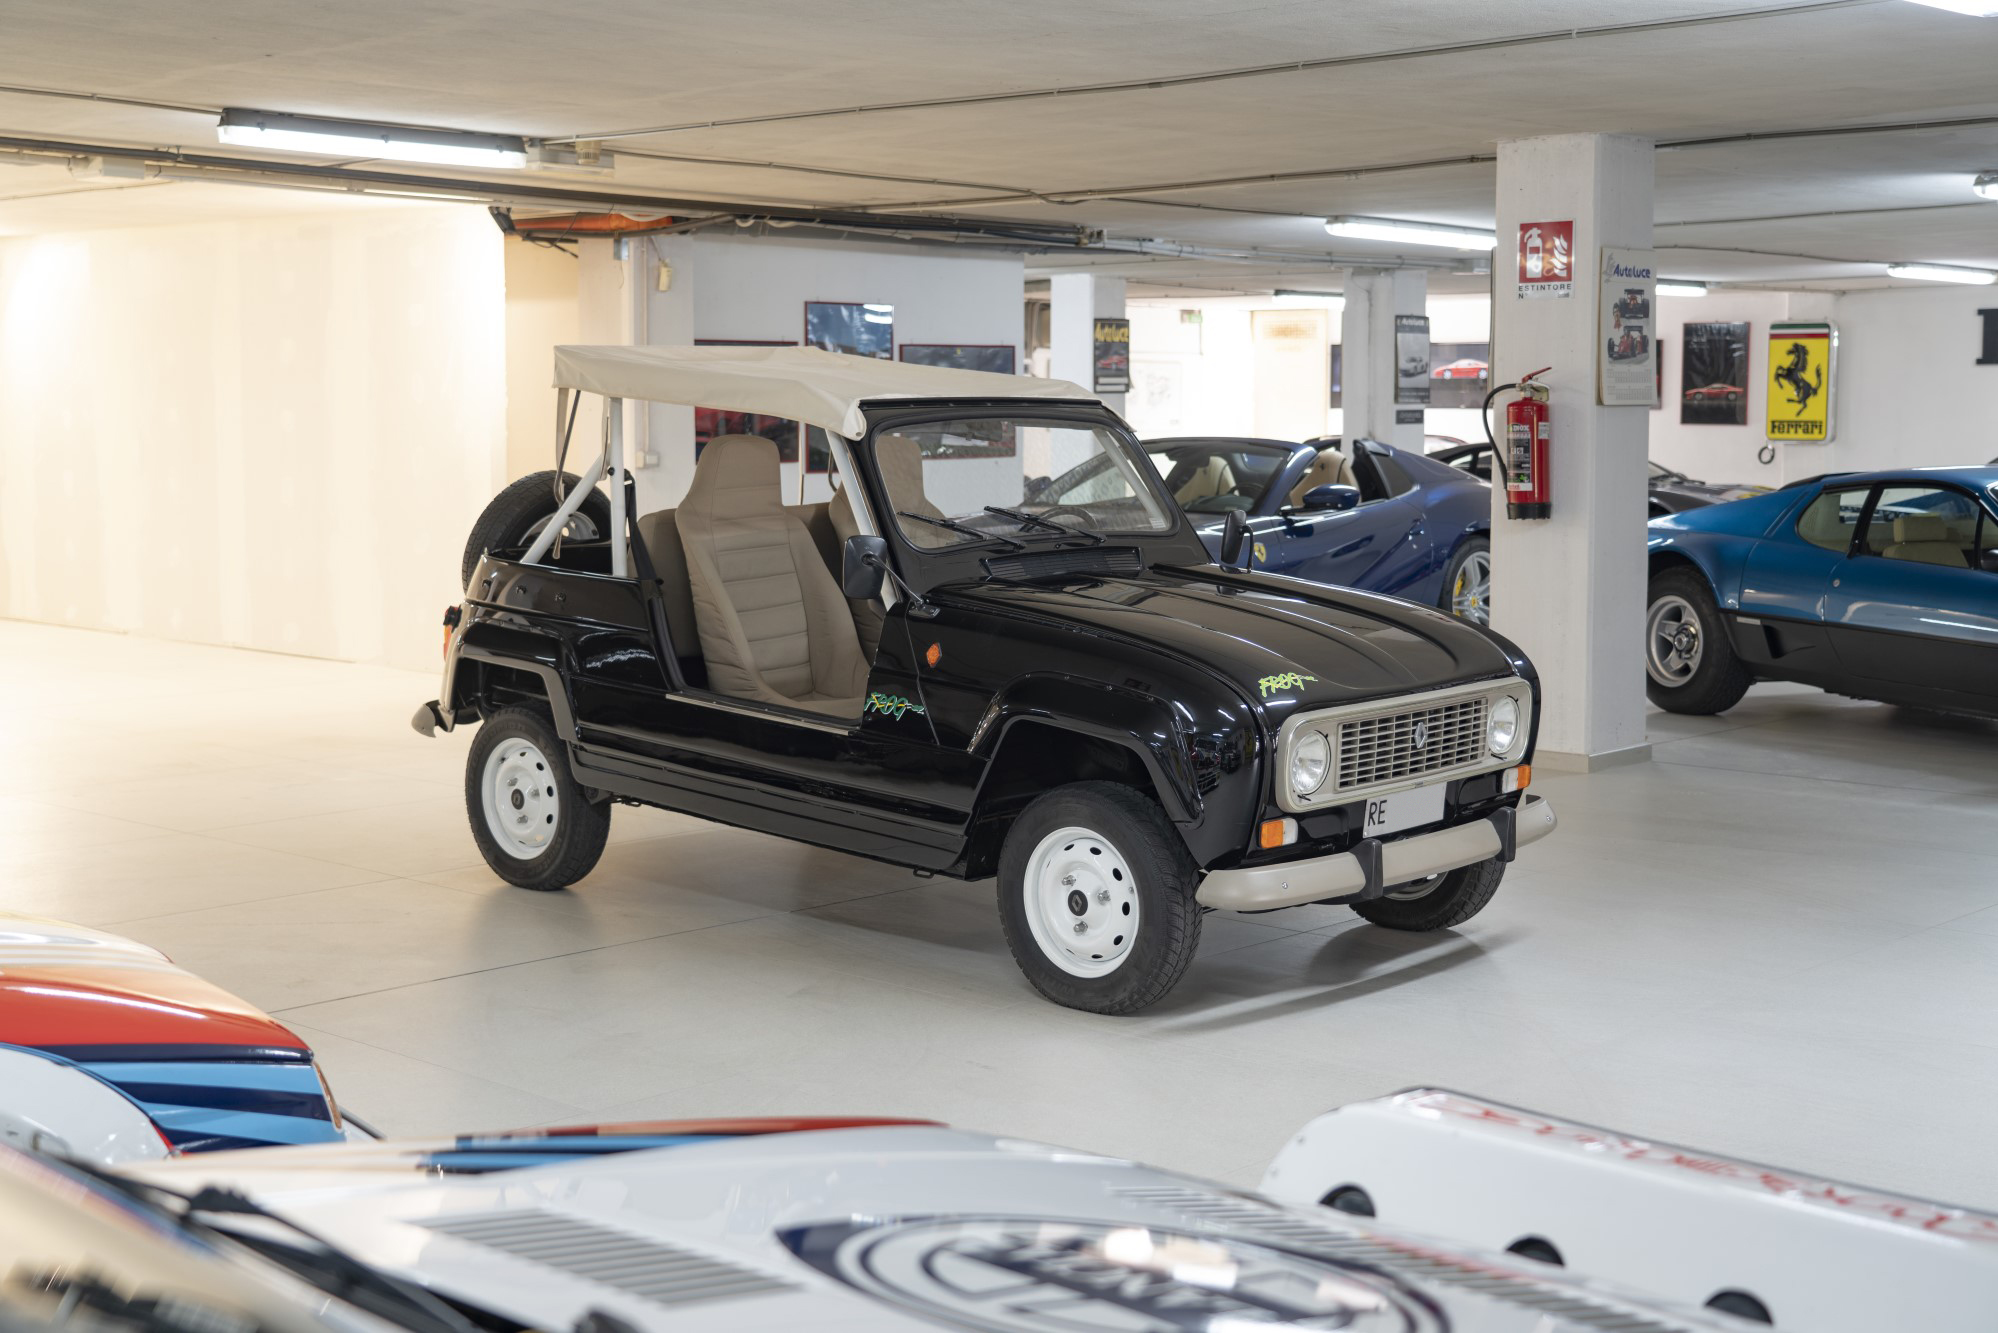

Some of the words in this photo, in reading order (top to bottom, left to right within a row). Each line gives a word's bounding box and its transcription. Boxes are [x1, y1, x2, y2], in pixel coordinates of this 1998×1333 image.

[1613, 264, 1651, 279] Autoluce
[1518, 283, 1572, 292] ESTINTORE
[1770, 419, 1823, 435] Ferrari
[1258, 671, 1318, 697] FROG
[863, 691, 925, 721] FROG
[1367, 799, 1388, 827] RE
